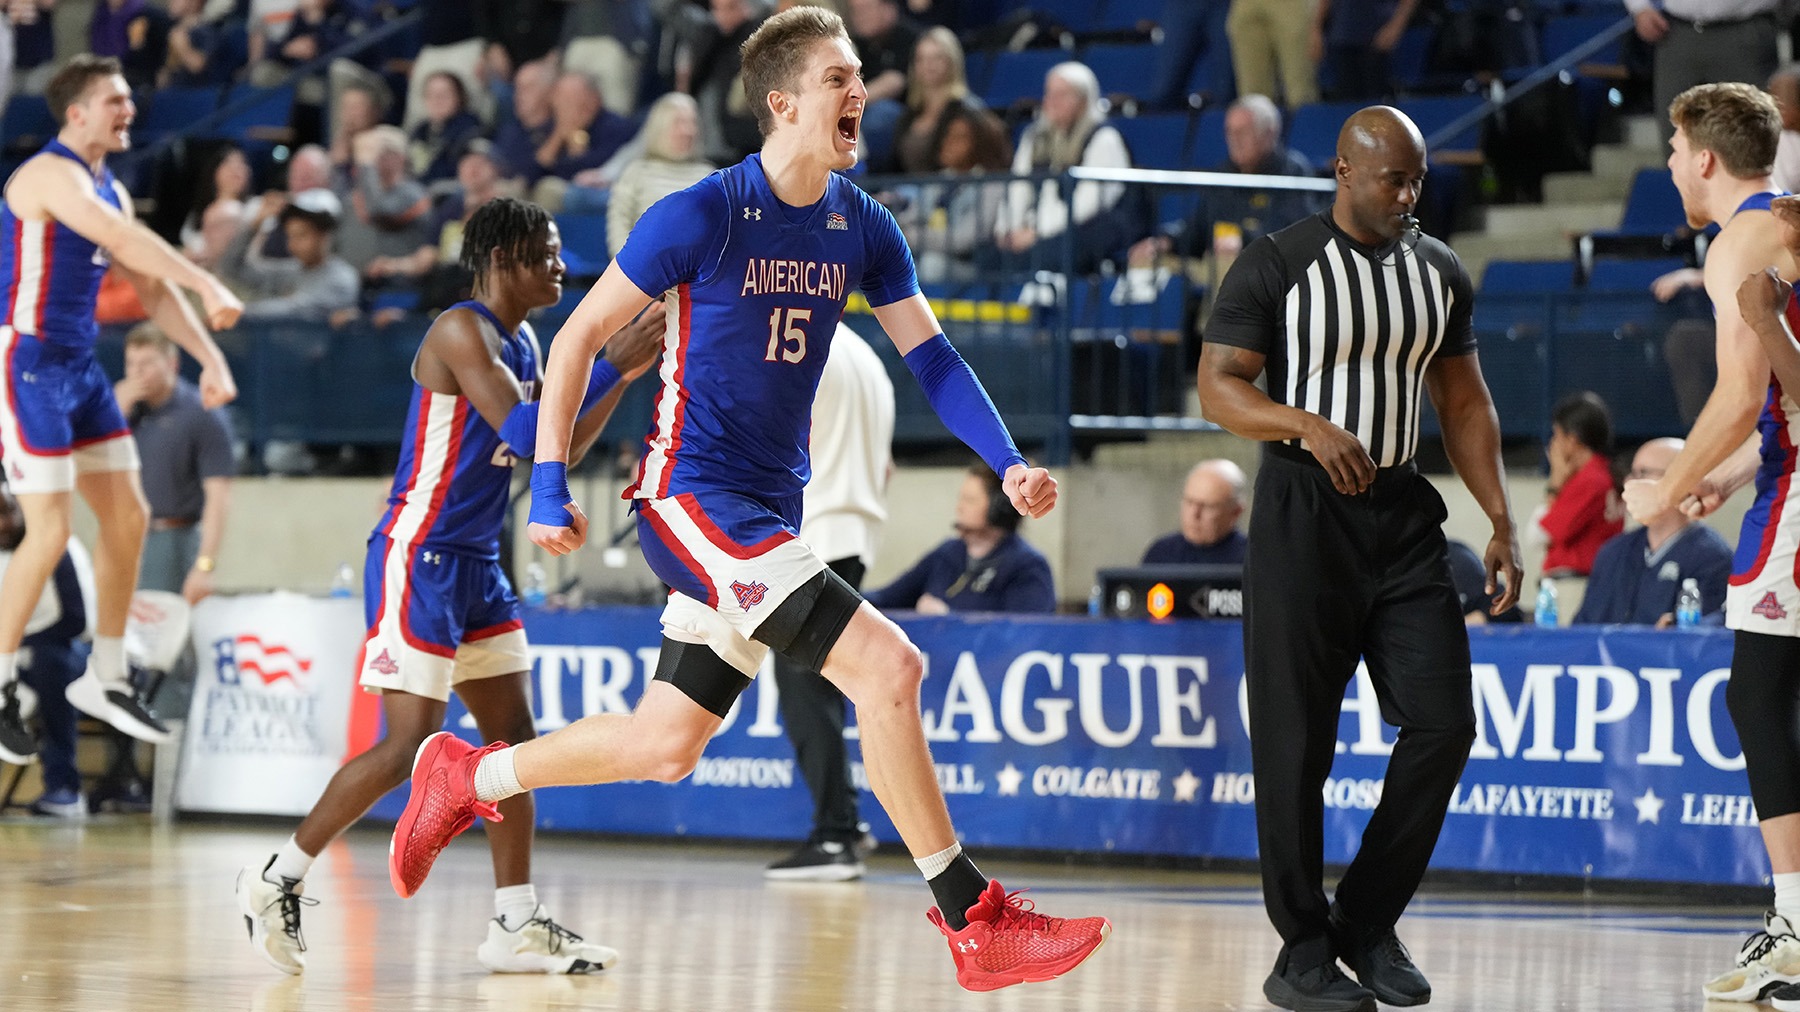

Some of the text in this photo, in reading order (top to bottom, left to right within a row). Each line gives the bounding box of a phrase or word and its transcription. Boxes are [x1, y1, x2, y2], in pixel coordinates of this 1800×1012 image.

[740, 257, 846, 302] AMERICAN
[764, 306, 812, 365] 15
[842, 650, 1217, 749] AGUE
[1032, 764, 1162, 800] COLGATE
[1211, 771, 1255, 805] HO
[1447, 782, 1614, 821] LAFAYETTE
